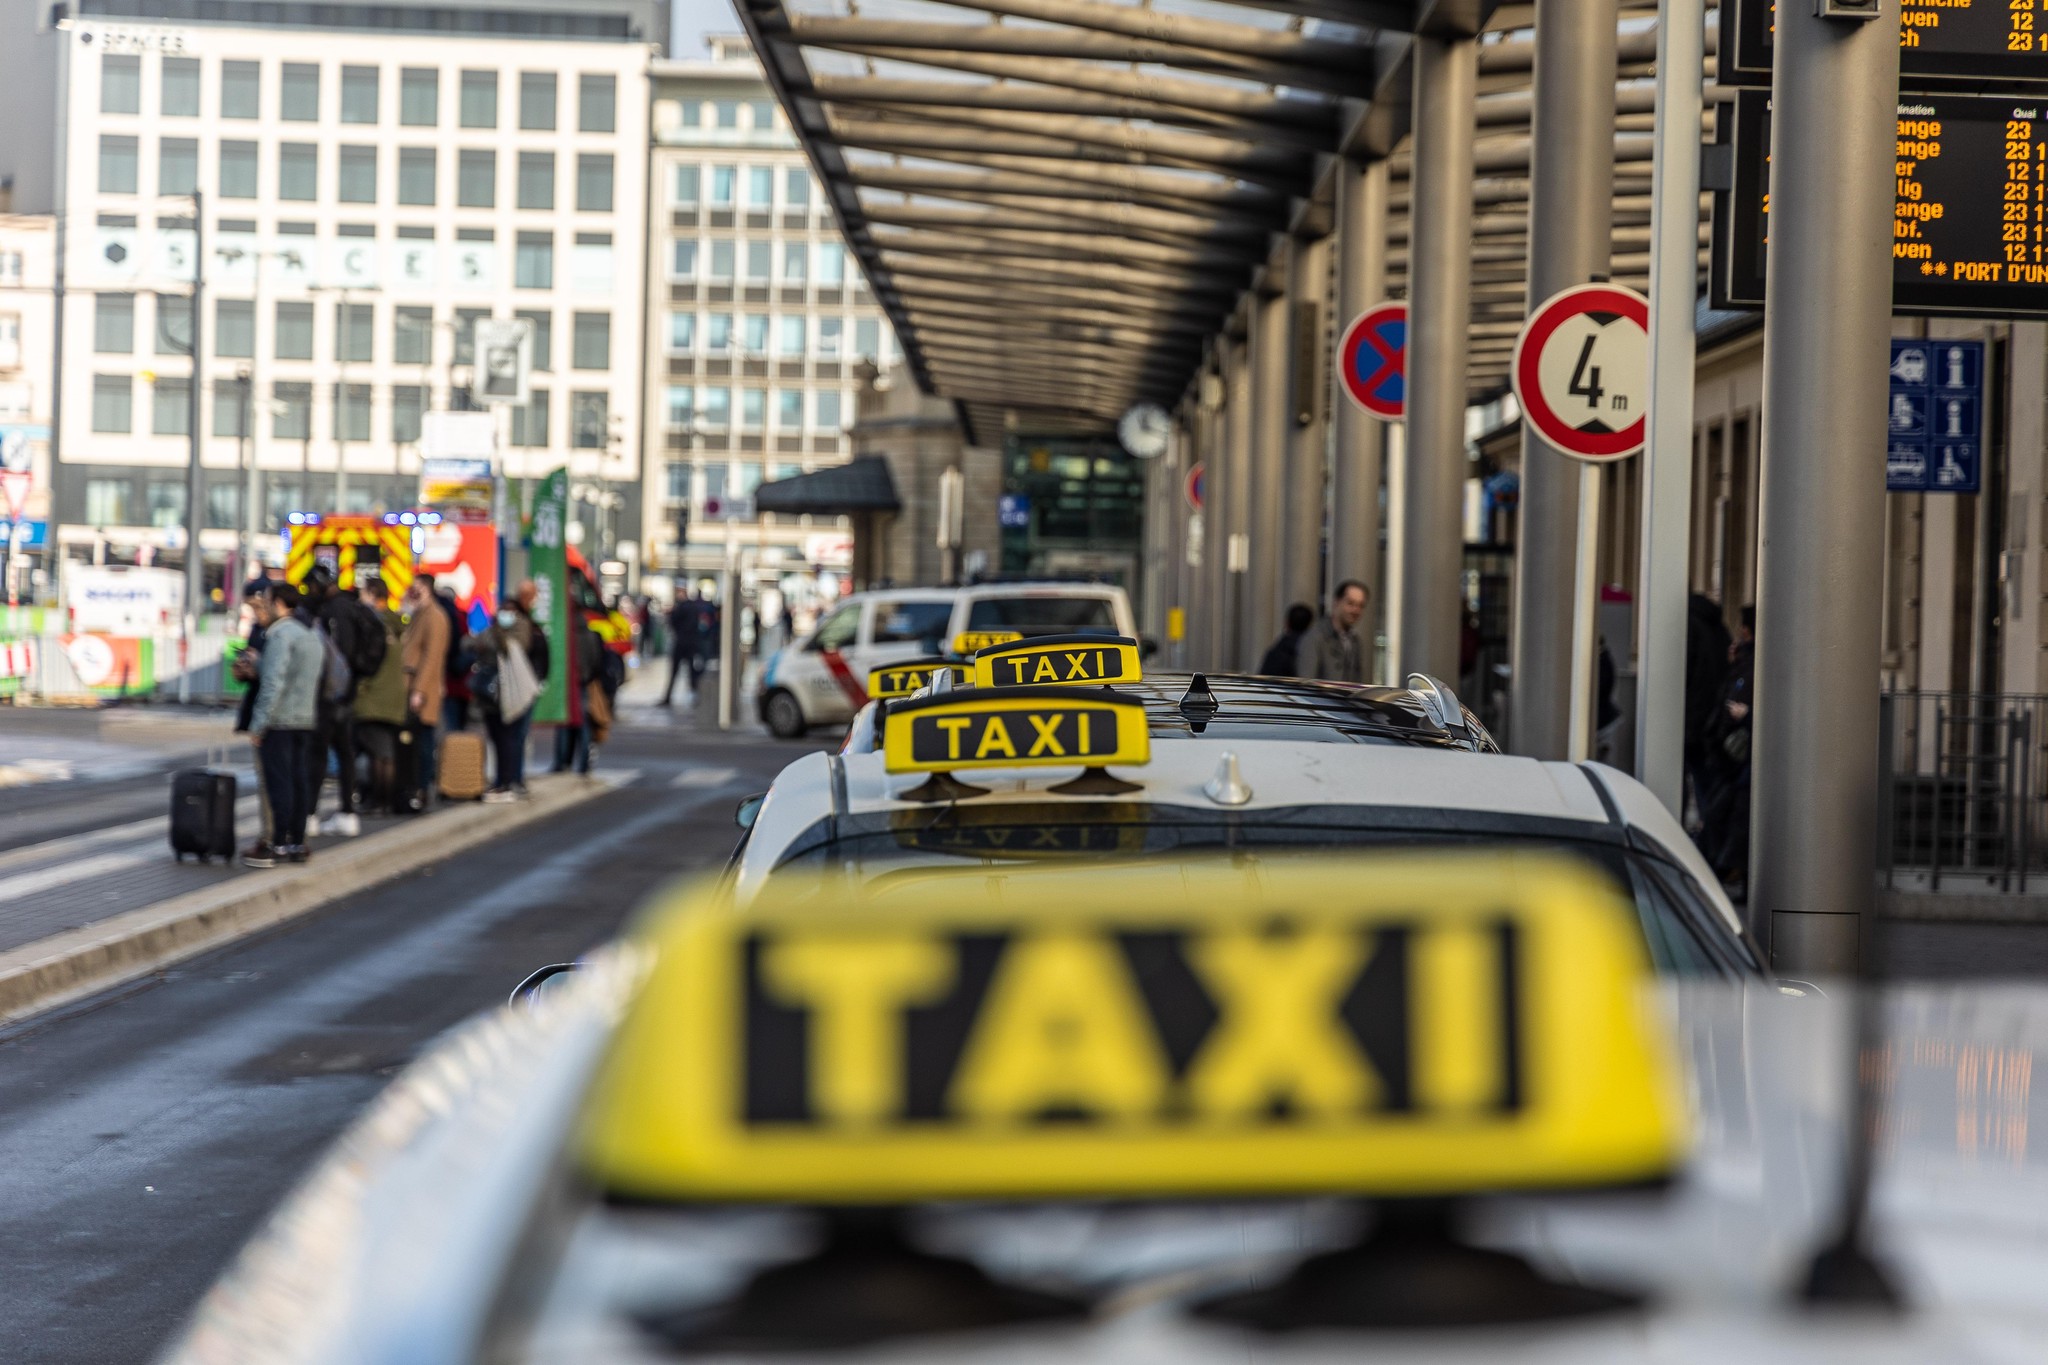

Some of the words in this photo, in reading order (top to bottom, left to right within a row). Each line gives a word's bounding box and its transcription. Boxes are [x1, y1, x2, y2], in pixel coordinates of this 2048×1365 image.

[1900, 11, 1939, 27] ven
[2010, 11, 2034, 30] 12
[2008, 31, 2033, 51] 23
[2013, 107, 2038, 119] Quai
[2005, 120, 2032, 140] 23
[2005, 141, 2031, 160] 23
[2006, 161, 2030, 180] 12
[2035, 162, 2048, 181] 1
[2003, 182, 2029, 201] 23
[2034, 183, 2048, 202] 1
[1895, 202, 1944, 222] ange
[2003, 202, 2028, 221] 23
[2033, 203, 2048, 222] 1
[1893, 219, 1923, 239] bf.
[2002, 222, 2027, 242] 23
[2033, 224, 2048, 242] 1
[1893, 242, 1932, 259] ven
[2003, 243, 2026, 262] 12
[1953, 261, 2003, 282] PORT
[2008, 263, 2048, 283] D'UN
[1568, 334, 1605, 408] 4
[1611, 393, 1628, 410] m
[1007, 651, 1104, 684] TAXI
[936, 712, 1091, 760] TAXI
[757, 922, 1506, 1122] TAXI
